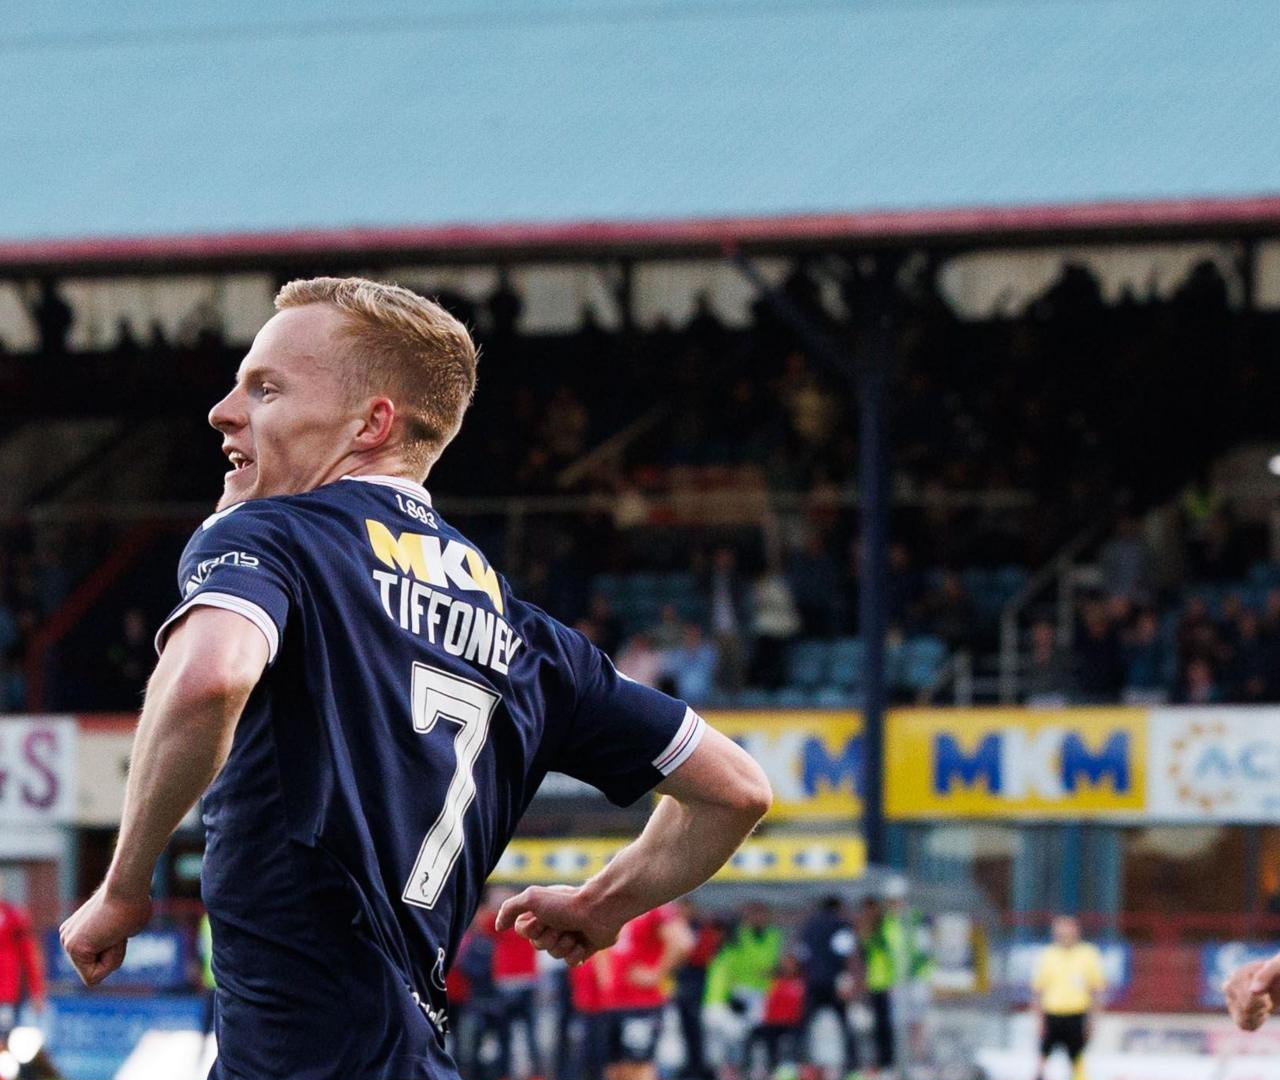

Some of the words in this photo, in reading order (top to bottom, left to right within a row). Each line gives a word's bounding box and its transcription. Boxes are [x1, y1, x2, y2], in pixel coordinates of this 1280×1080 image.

[395, 494, 438, 530] 1893
[372, 569, 522, 676] TIFFONEY
[402, 661, 503, 909] 7
[733, 731, 865, 799] KM
[933, 731, 1132, 799] MKM
